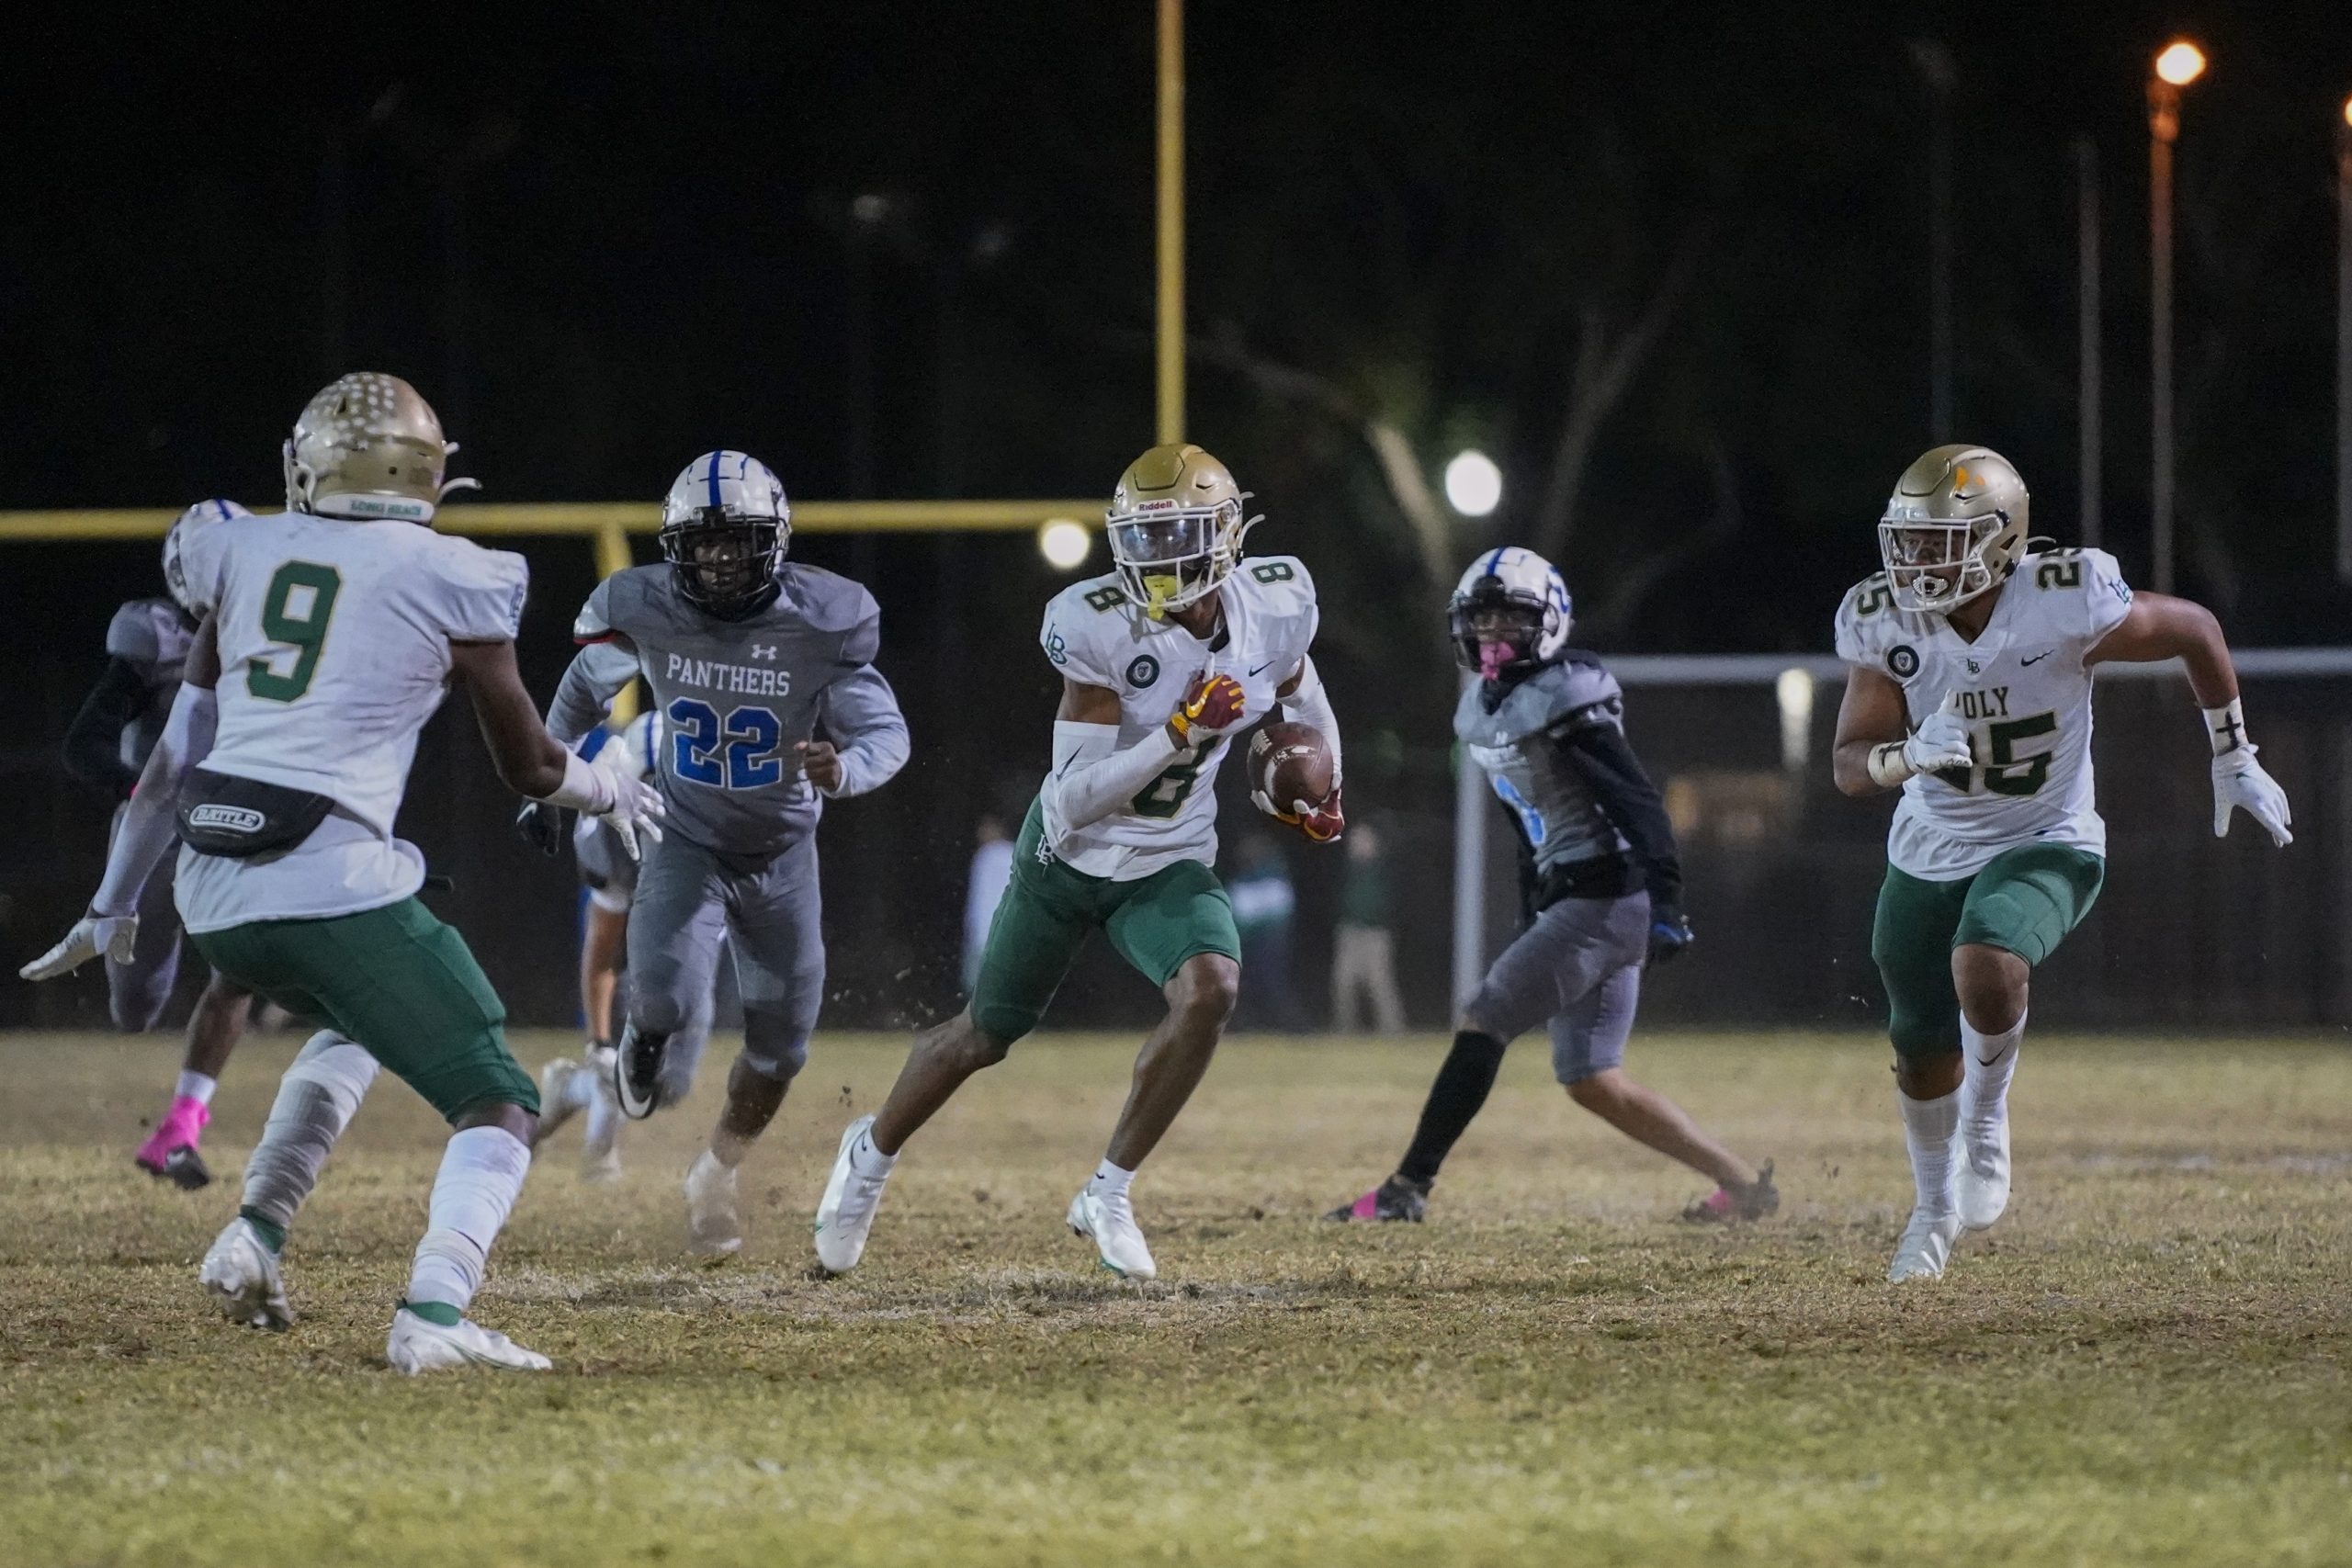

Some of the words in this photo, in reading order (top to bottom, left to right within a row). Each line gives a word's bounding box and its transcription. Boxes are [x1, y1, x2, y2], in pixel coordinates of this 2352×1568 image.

[1139, 501, 1172, 511] Riddell
[1248, 561, 1295, 586] 8
[1082, 586, 1126, 615] 8
[244, 558, 344, 705] 9
[666, 652, 791, 696] PANTHERS
[1954, 686, 2009, 720] OLY
[666, 695, 782, 791] 22
